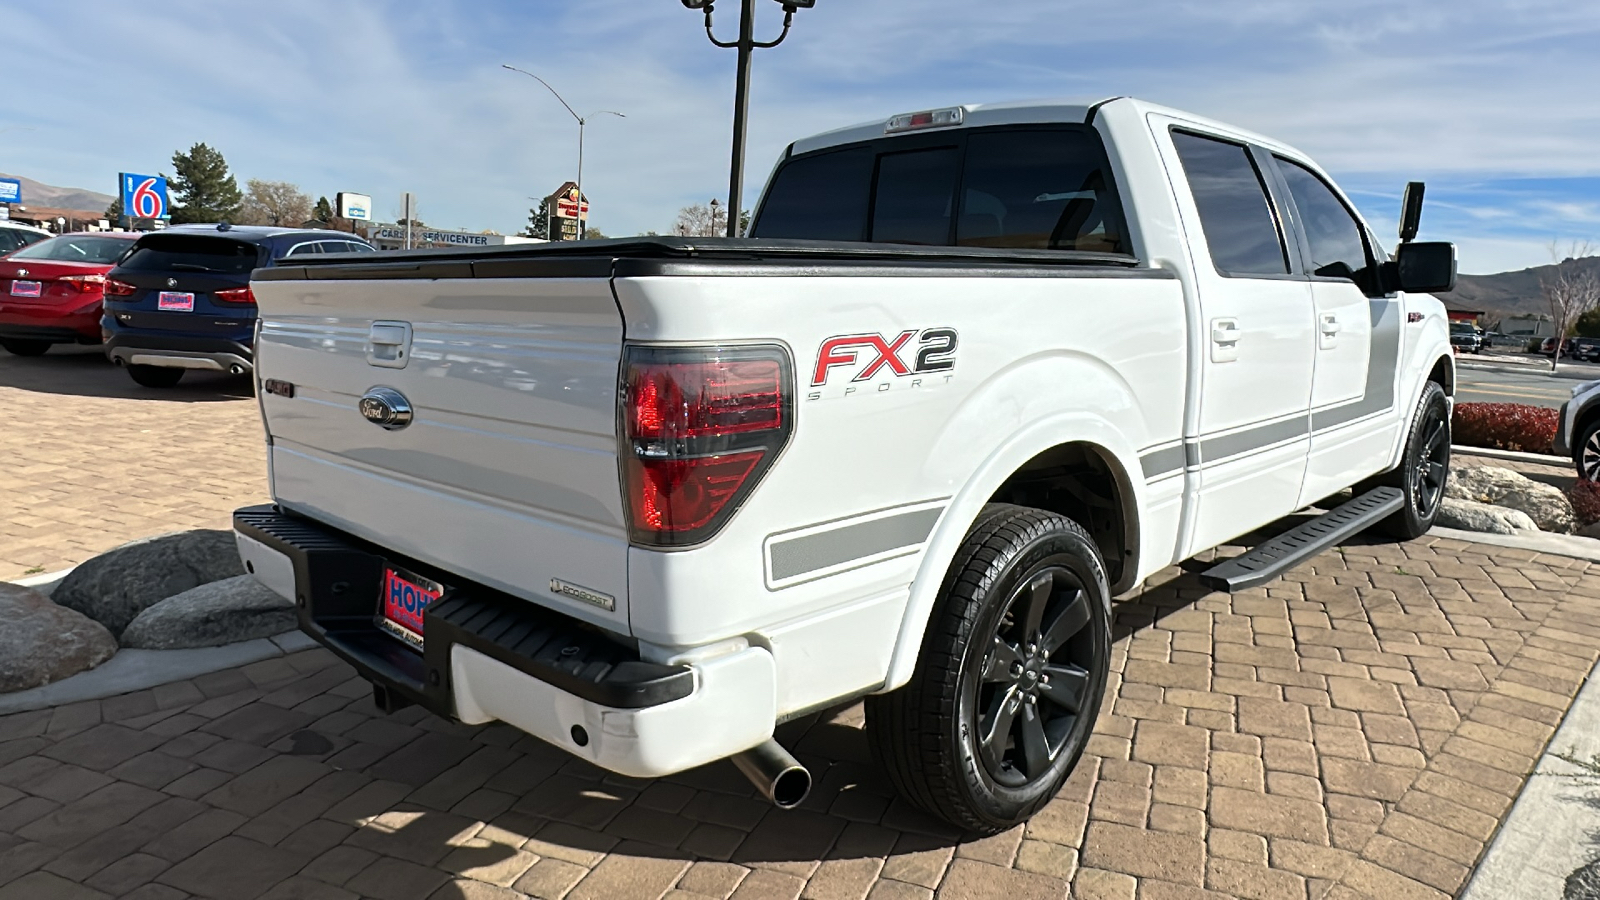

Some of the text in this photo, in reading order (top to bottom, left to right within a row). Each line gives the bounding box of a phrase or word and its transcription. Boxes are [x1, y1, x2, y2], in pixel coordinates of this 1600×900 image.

[133, 178, 163, 218] 6
[422, 232, 487, 245] SERVICENTER
[810, 327, 959, 387] FX2
[808, 375, 953, 401] SPORT
[362, 398, 383, 419] Ford
[390, 577, 434, 617] HOH
